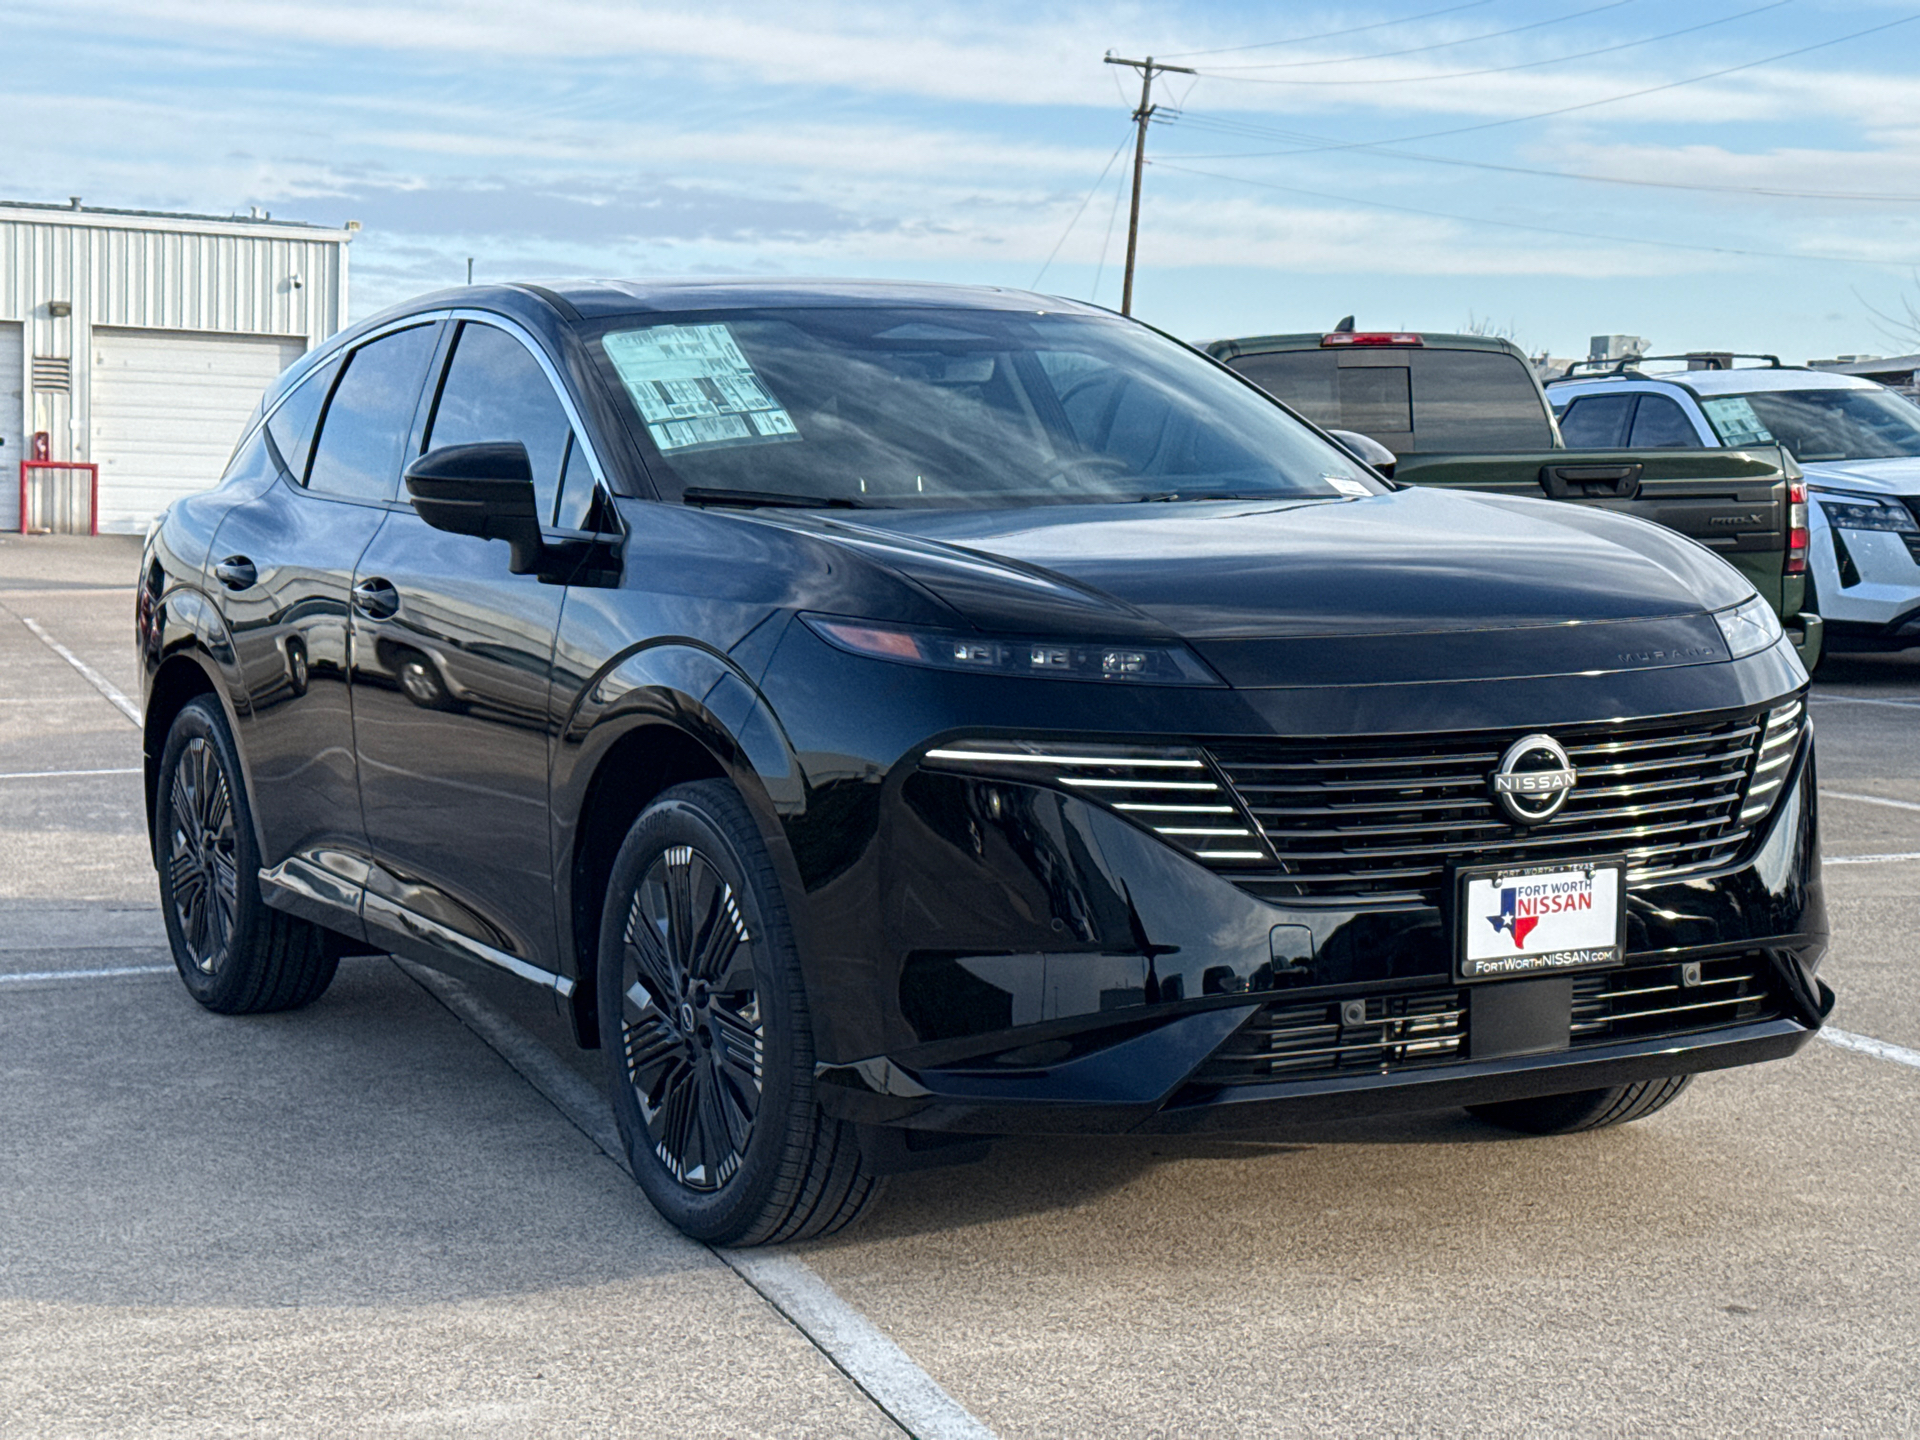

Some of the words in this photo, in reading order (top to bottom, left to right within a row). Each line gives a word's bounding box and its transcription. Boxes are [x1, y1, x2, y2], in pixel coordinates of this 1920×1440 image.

[1617, 646, 1715, 662] MURANO
[1497, 771, 1576, 790] NISSAN
[1524, 866, 1554, 876] WORTH
[1568, 863, 1595, 872] TEXAS
[1518, 885, 1548, 897] FORT
[1551, 879, 1592, 894] WORTH
[1518, 891, 1592, 916] NISSAN
